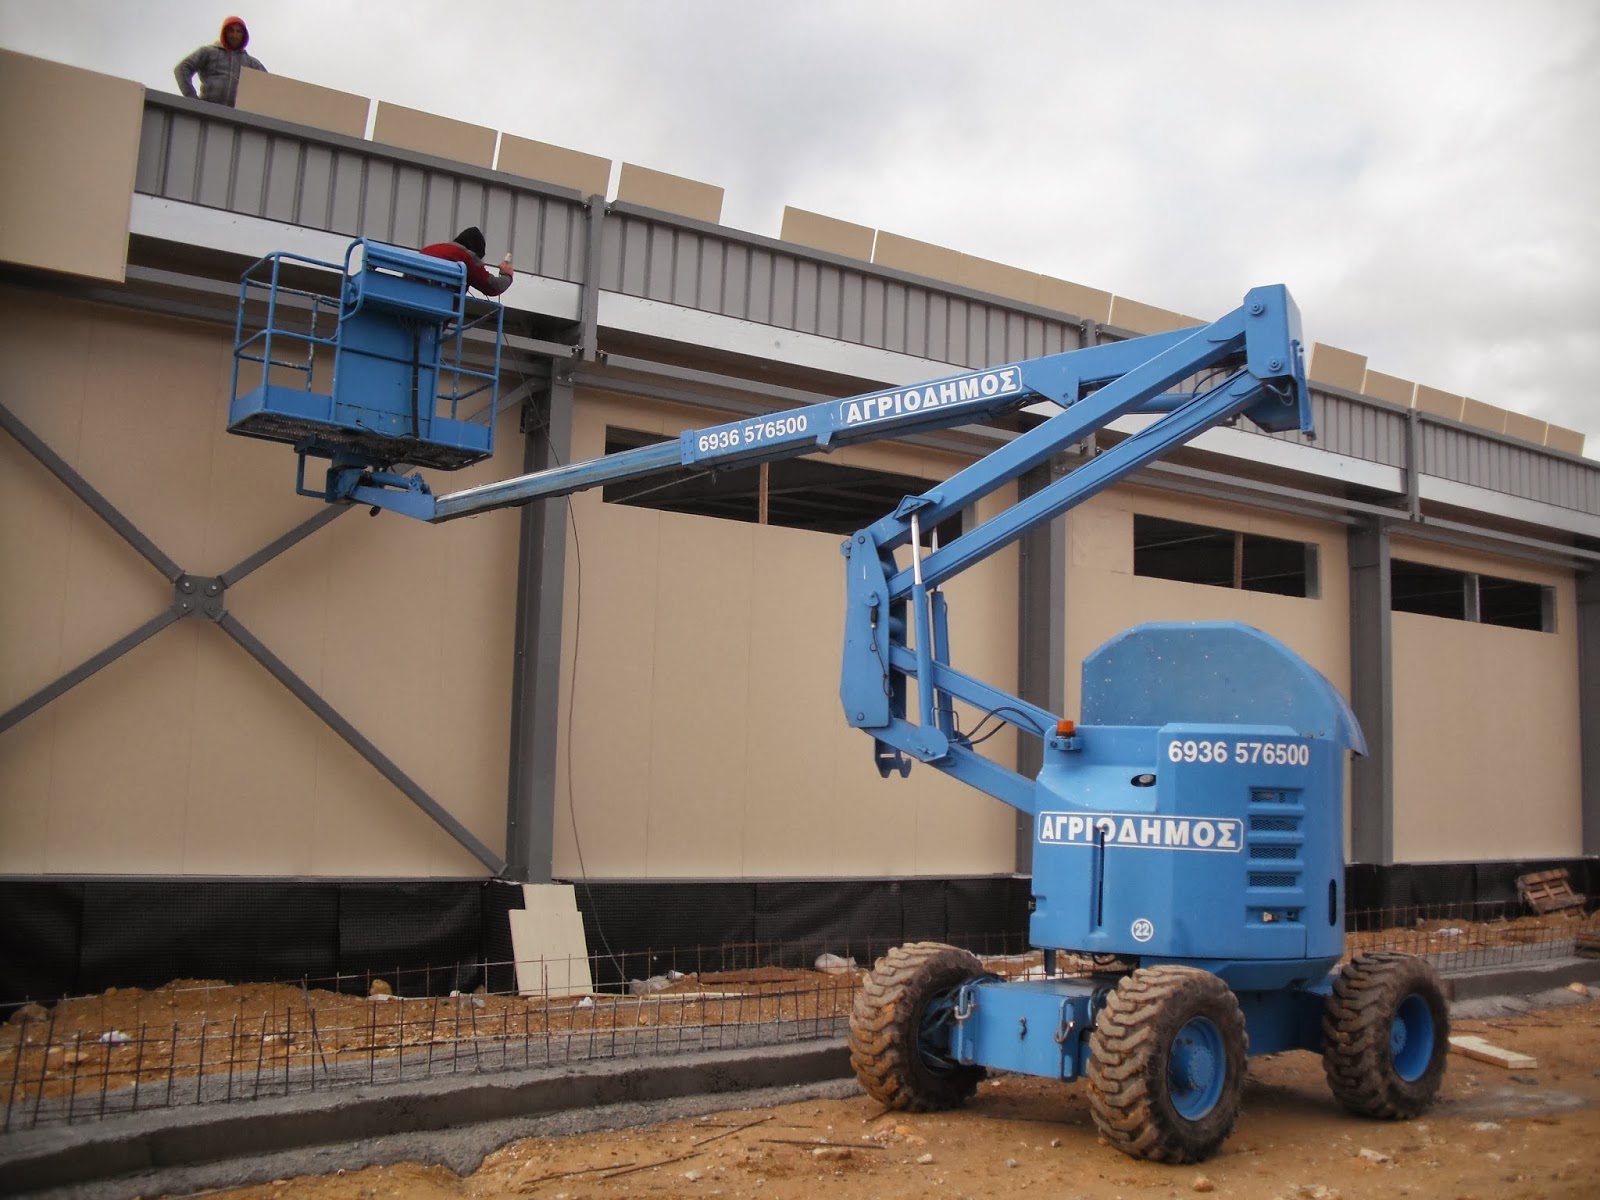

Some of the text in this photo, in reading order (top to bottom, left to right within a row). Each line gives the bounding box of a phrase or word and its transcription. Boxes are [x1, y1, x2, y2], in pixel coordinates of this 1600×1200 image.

[846, 370, 1017, 425] ΑΓΡΙΟΔΗΜΟΣ
[698, 414, 808, 452] 6936 576500
[1168, 740, 1310, 766] 6936 576500
[1041, 815, 1237, 848] ΑΓΡΙΟΔΗΜΟΣ
[1134, 922, 1151, 938] 22
